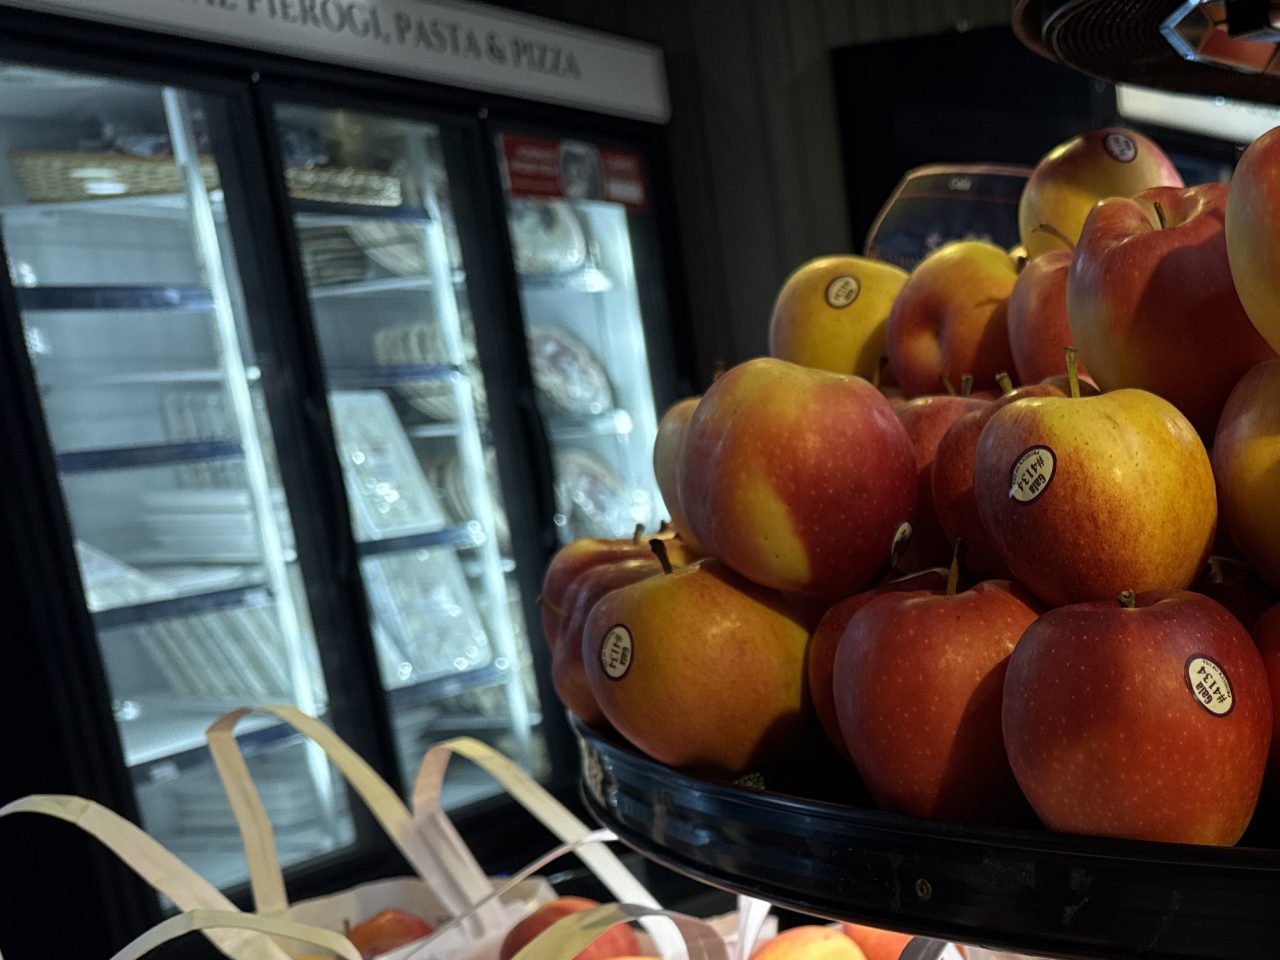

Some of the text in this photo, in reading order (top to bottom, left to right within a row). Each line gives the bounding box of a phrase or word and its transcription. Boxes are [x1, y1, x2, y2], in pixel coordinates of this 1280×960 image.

[393, 10, 482, 60] PASTA
[484, 30, 507, 65] &
[509, 35, 582, 81] PIZZA
[1017, 455, 1045, 492] #4134
[1028, 473, 1047, 494] Gala
[1195, 680, 1213, 705] Gala
[1196, 665, 1228, 704] #4134
